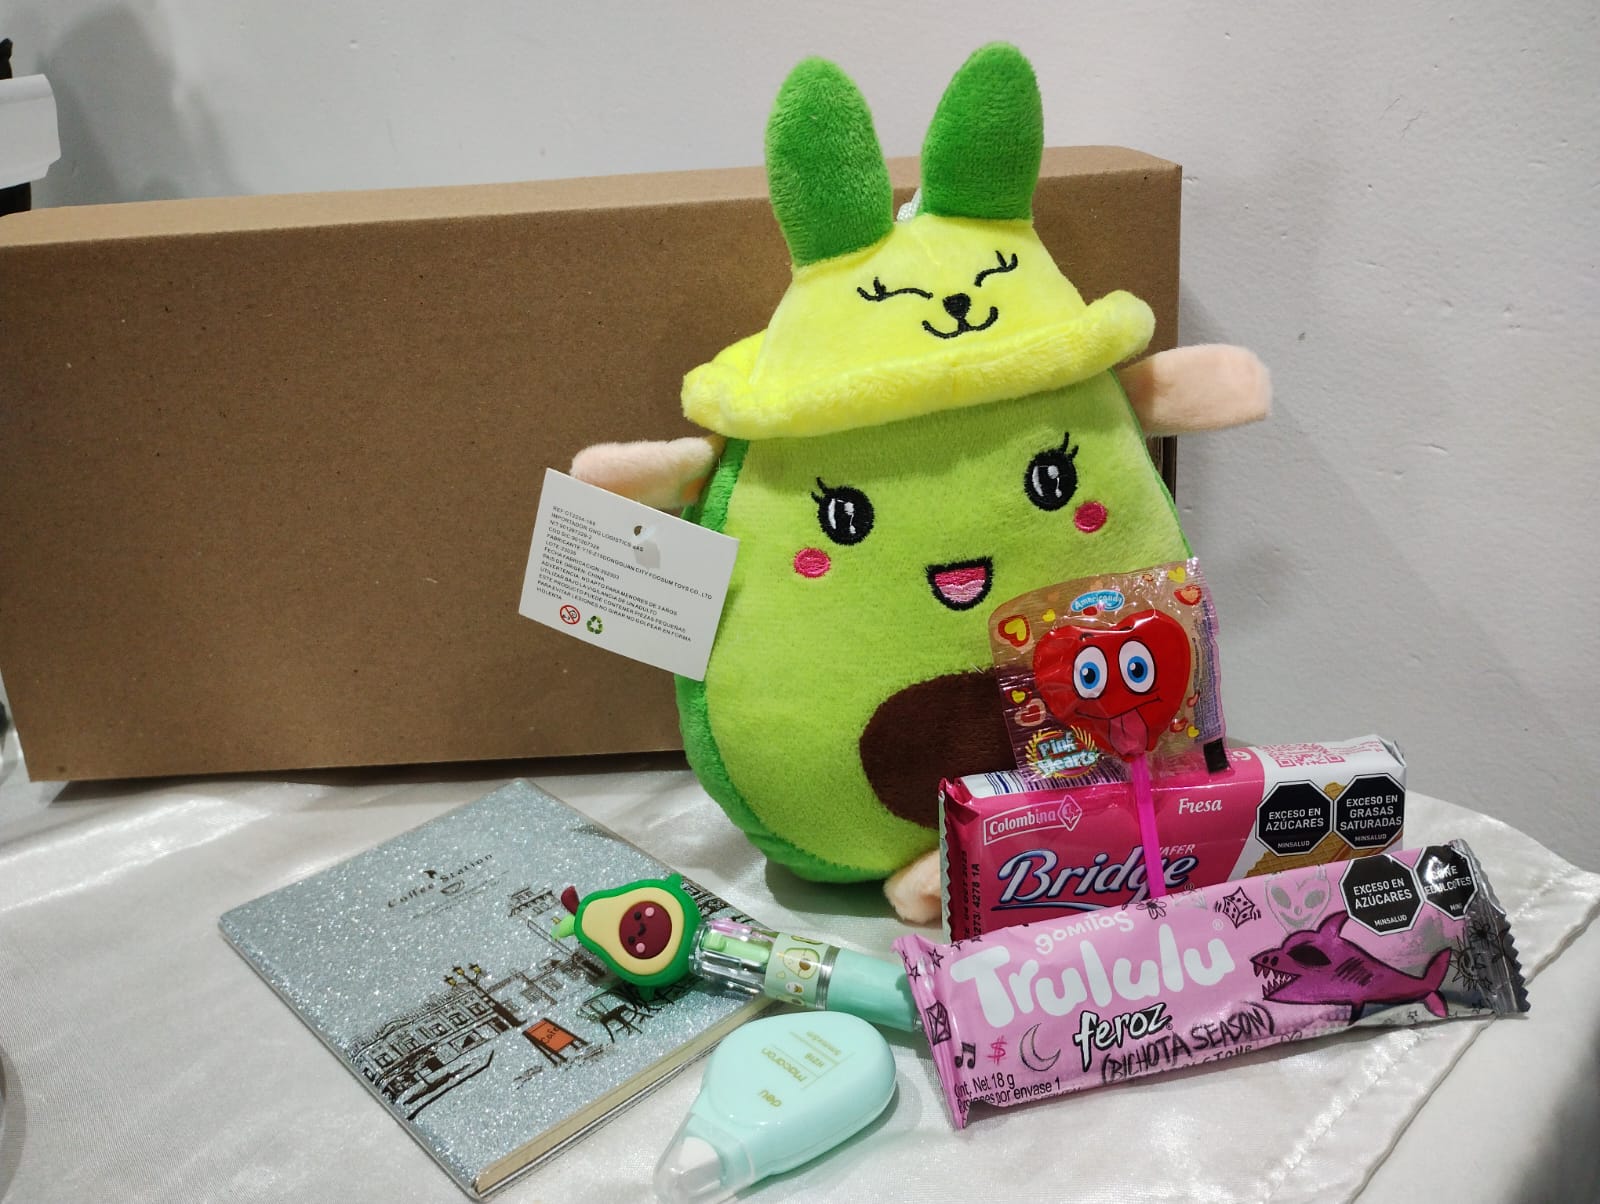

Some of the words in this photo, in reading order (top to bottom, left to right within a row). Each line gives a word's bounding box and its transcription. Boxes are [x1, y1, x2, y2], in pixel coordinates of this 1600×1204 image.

[1038, 731, 1077, 756] Pink
[1037, 751, 1097, 776] Hearts
[1178, 798, 1222, 814] Fresa
[1346, 796, 1383, 807] EXCESO
[1386, 795, 1398, 803] EN
[1268, 809, 1306, 820] EXCESO
[1308, 808, 1321, 816] EN
[1350, 806, 1394, 818] GRASAS
[989, 809, 1056, 836] Colombina
[1266, 818, 1324, 832] AZÚCARES
[1340, 816, 1402, 830] SATURADAS
[1278, 840, 1310, 848] MINSALUD
[1354, 834, 1387, 842] MINSALUD
[388, 883, 434, 908] Coffee
[440, 853, 492, 882] Station
[1354, 882, 1390, 896] EXCESO
[1392, 878, 1404, 888] EN
[1354, 889, 1412, 909] AZÚCARES
[1374, 914, 1407, 926] MINSALUD
[1034, 910, 1134, 954] gomitas
[950, 923, 1236, 1028] Trululu
[1072, 1002, 1172, 1072] feroz
[761, 1047, 807, 1082] macaron
[992, 1072, 1004, 1088] 18
[1007, 1074, 1015, 1089] g
[1014, 1082, 1052, 1099] envase
[1054, 1076, 1060, 1090] 1
